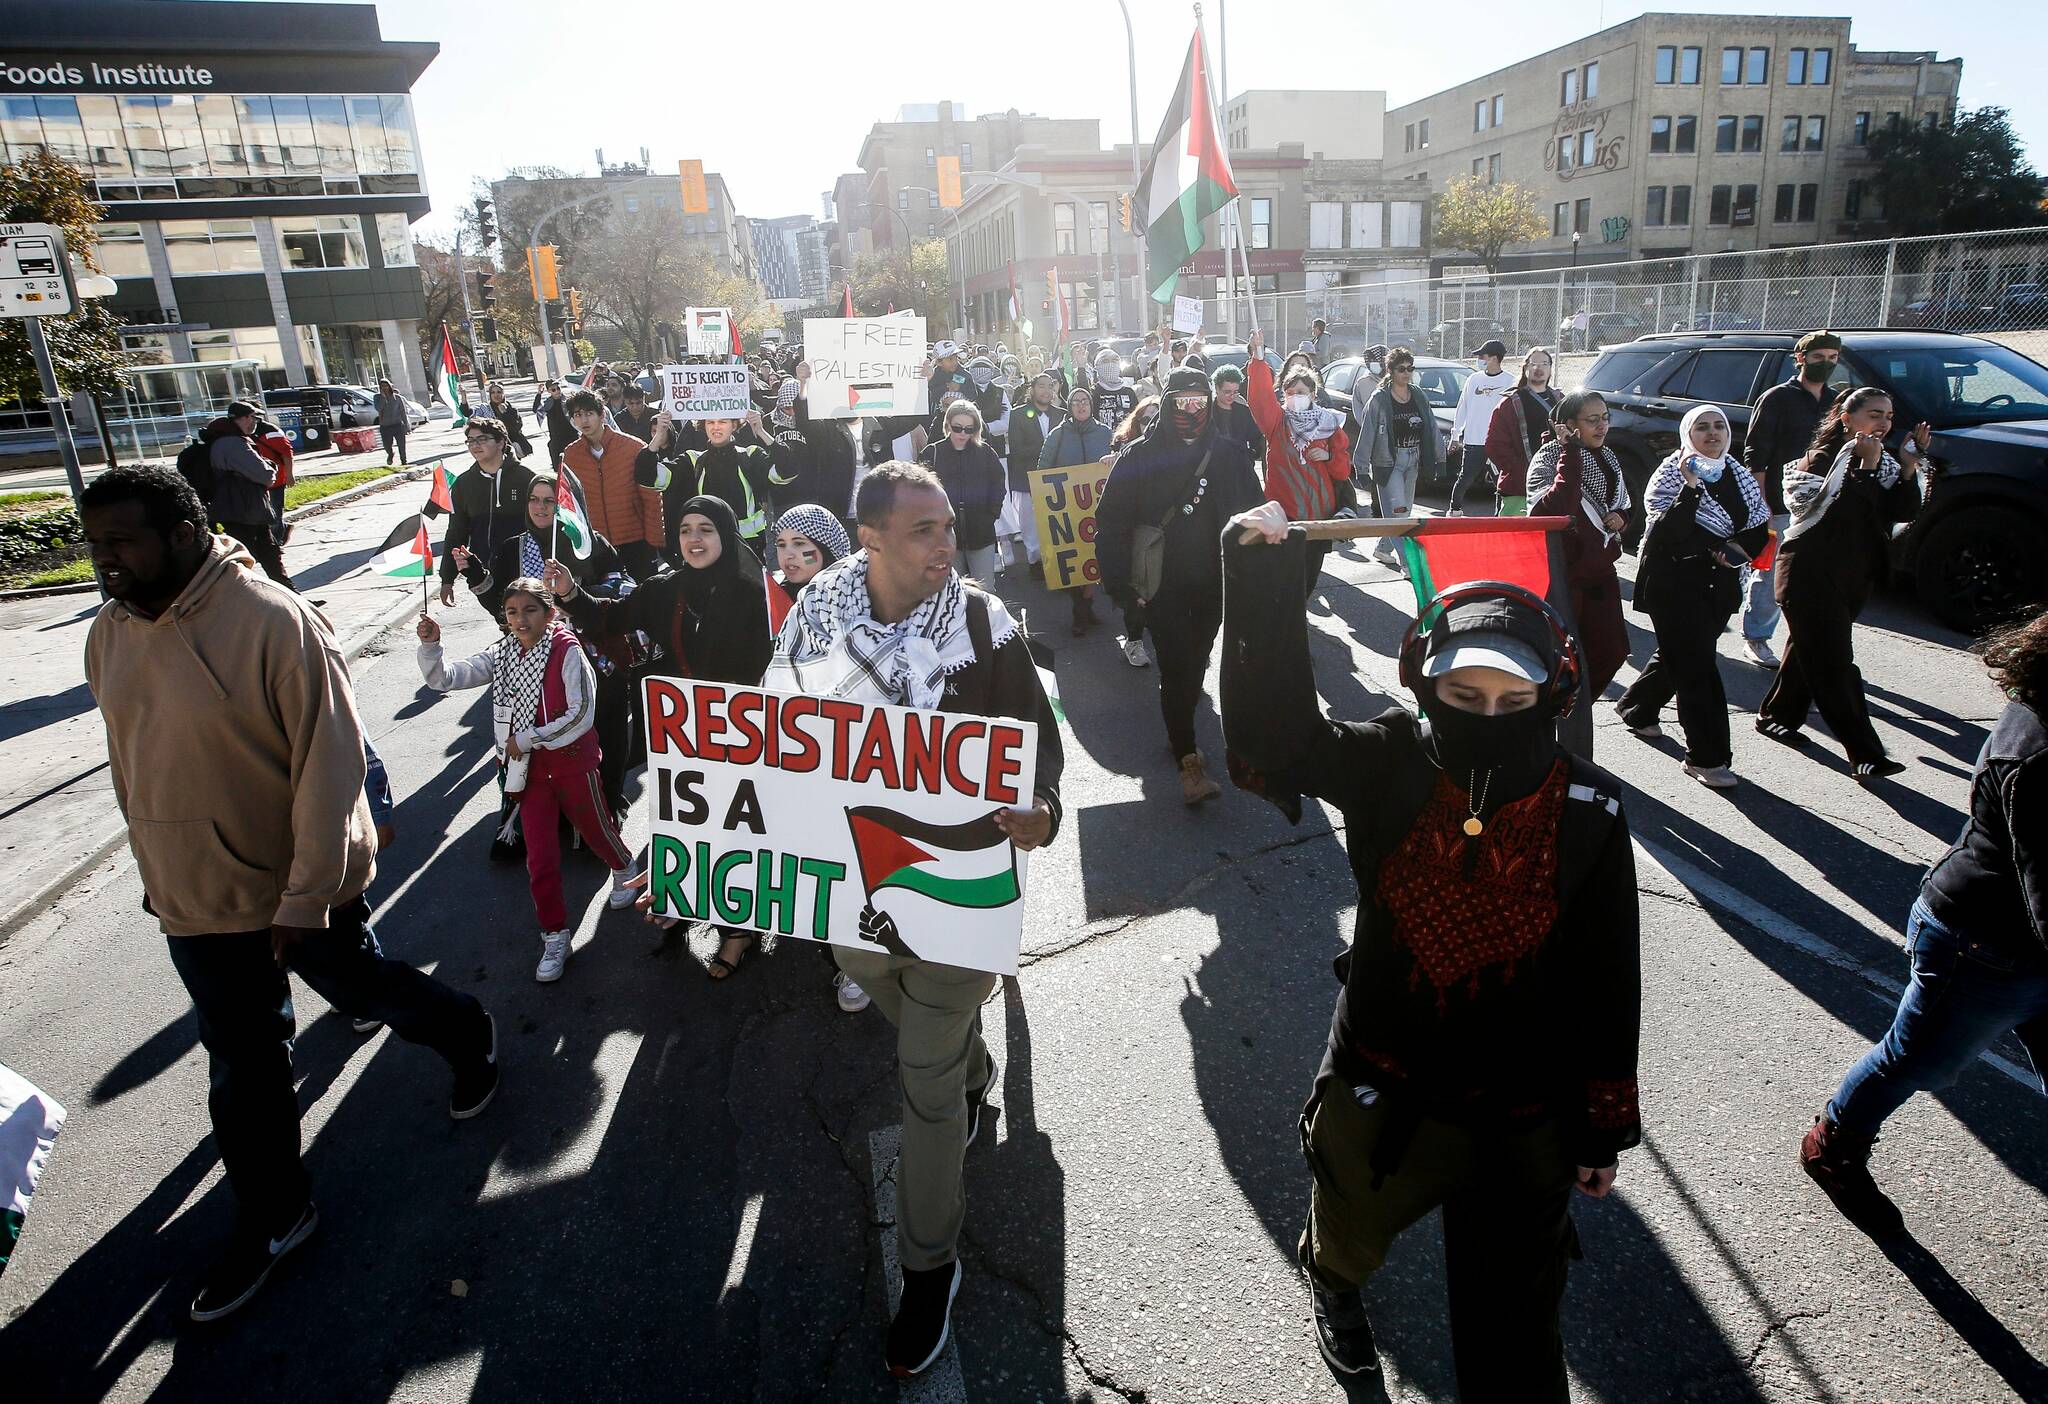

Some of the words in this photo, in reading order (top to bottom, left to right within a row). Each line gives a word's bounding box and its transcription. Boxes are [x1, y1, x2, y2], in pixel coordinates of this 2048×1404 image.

[91, 62, 213, 85] Institute
[25, 282, 35, 290] 12
[46, 281, 59, 289] 23
[26, 293, 39, 302] 65
[48, 292, 61, 300] 66
[701, 332, 721, 341] FREE
[844, 323, 914, 350] FREE
[689, 341, 728, 354] PALESTIN
[813, 359, 926, 380] PALESTINE
[671, 372, 683, 385] IT
[686, 372, 698, 385] IS
[700, 371, 729, 384] RIGHT
[731, 371, 746, 384] TO
[702, 385, 747, 398] AGAINST
[675, 398, 748, 412] OCCUPATION
[774, 430, 807, 445] OCTOBER
[645, 679, 1023, 805] RESISTANCE
[657, 768, 710, 825] IS
[723, 779, 767, 834] A
[651, 833, 847, 941] RIGHT
